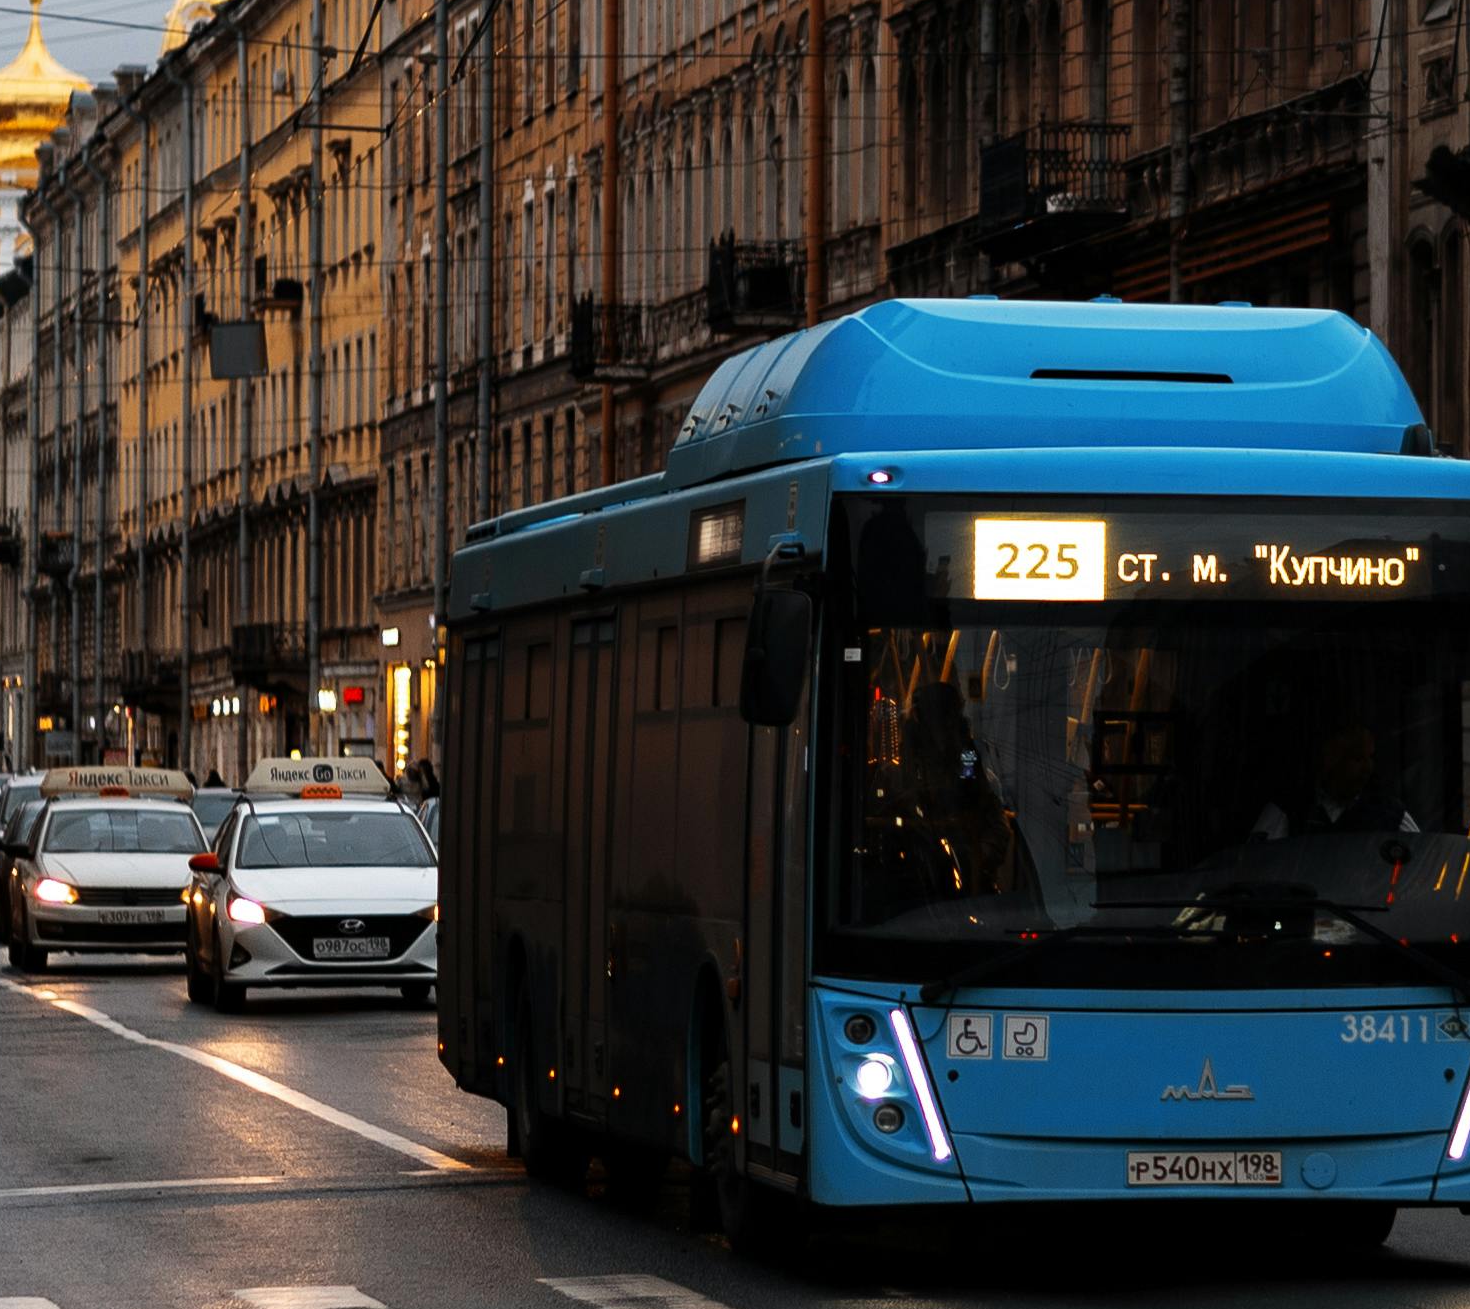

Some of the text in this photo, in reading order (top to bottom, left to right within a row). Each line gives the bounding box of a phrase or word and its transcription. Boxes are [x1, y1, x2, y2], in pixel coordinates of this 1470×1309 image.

[995, 542, 1080, 580] 225
[1254, 544, 1419, 588] "Купчино"
[67, 769, 169, 788] Яндекс Такси
[269, 766, 367, 783] Яндекс Go Такси
[1340, 1014, 1428, 1043] 38411
[1135, 1154, 1275, 1182] Р540НХ 198
[1246, 1174, 1265, 1182] RUS
